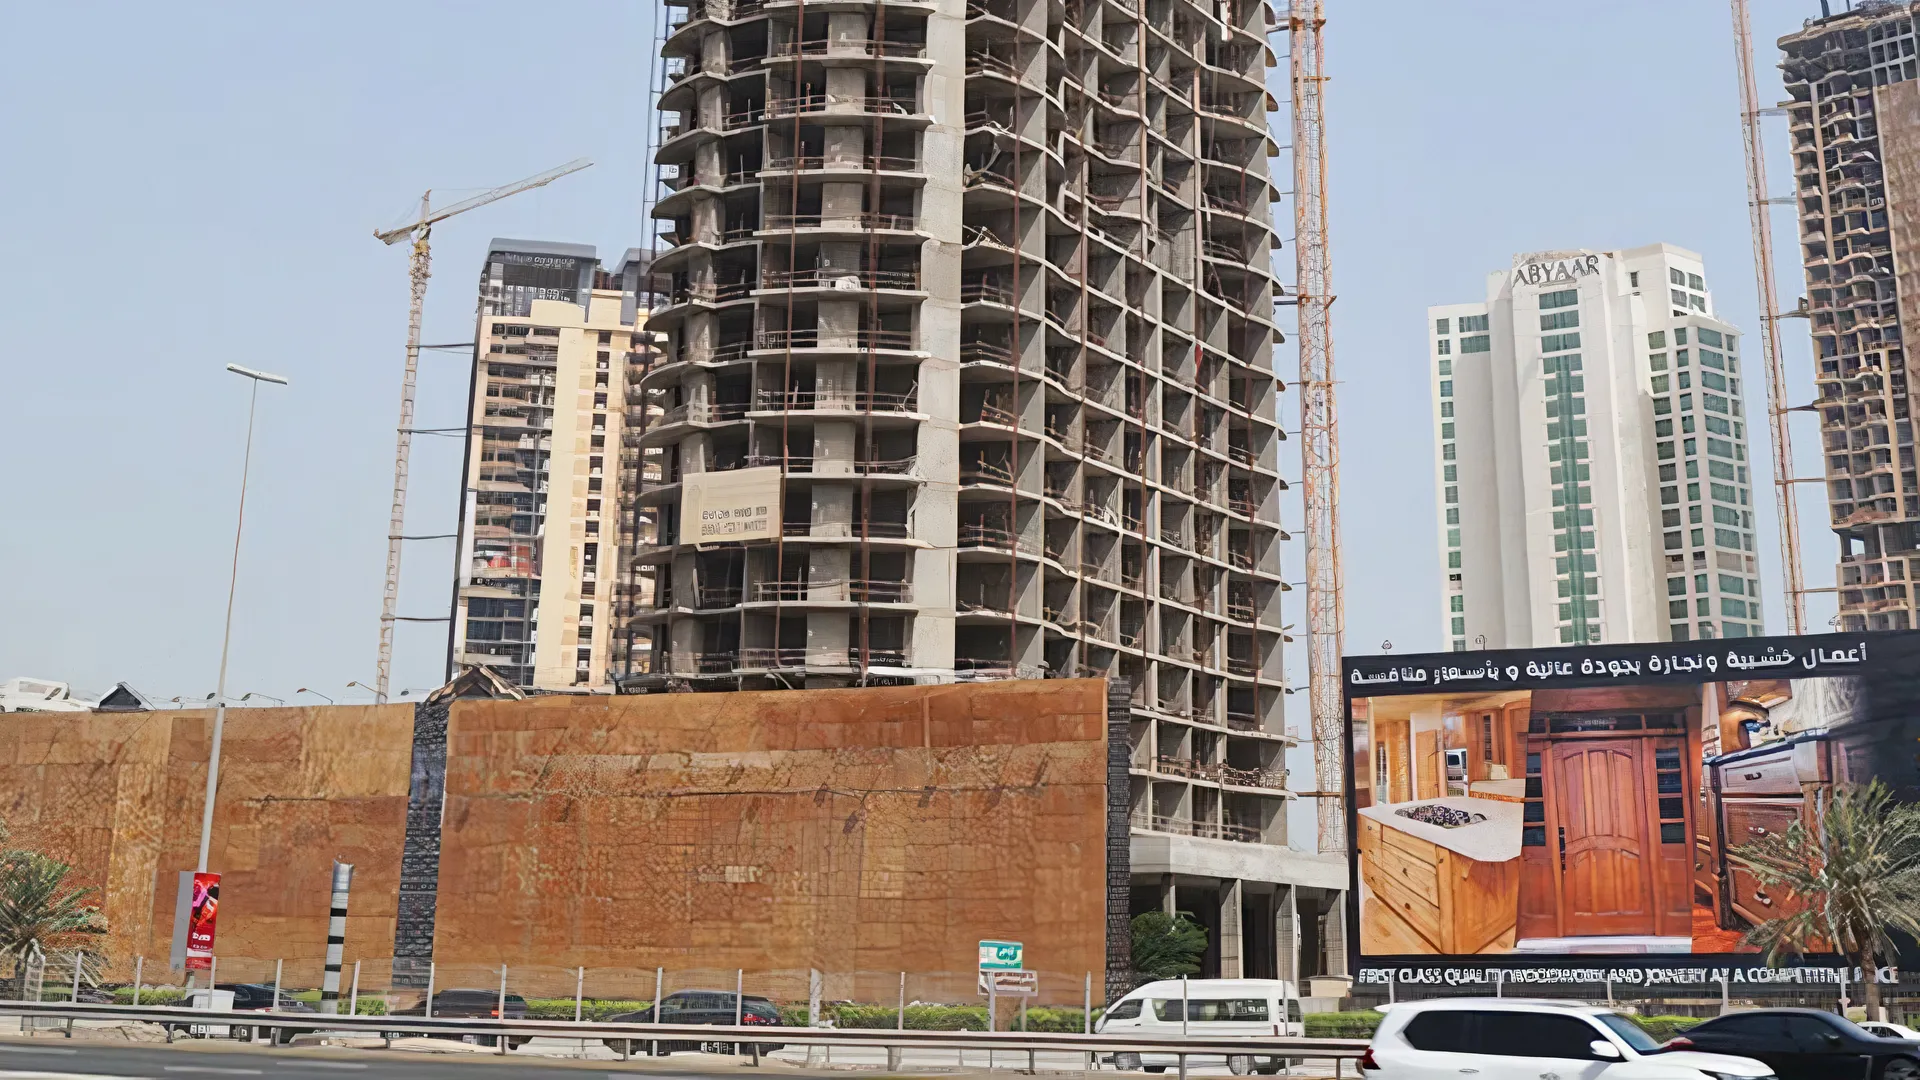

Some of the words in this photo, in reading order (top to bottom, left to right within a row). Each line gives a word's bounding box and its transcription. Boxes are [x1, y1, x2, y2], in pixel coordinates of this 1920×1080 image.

[1512, 254, 1600, 288] ABYAAR
[1726, 646, 1796, 670] خشبية
[1802, 642, 1867, 670] أعمال
[1525, 660, 1573, 679] عالية
[1580, 658, 1641, 678] بجودة
[1398, 968, 1442, 984] CLASS
[1733, 968, 1746, 983] A
